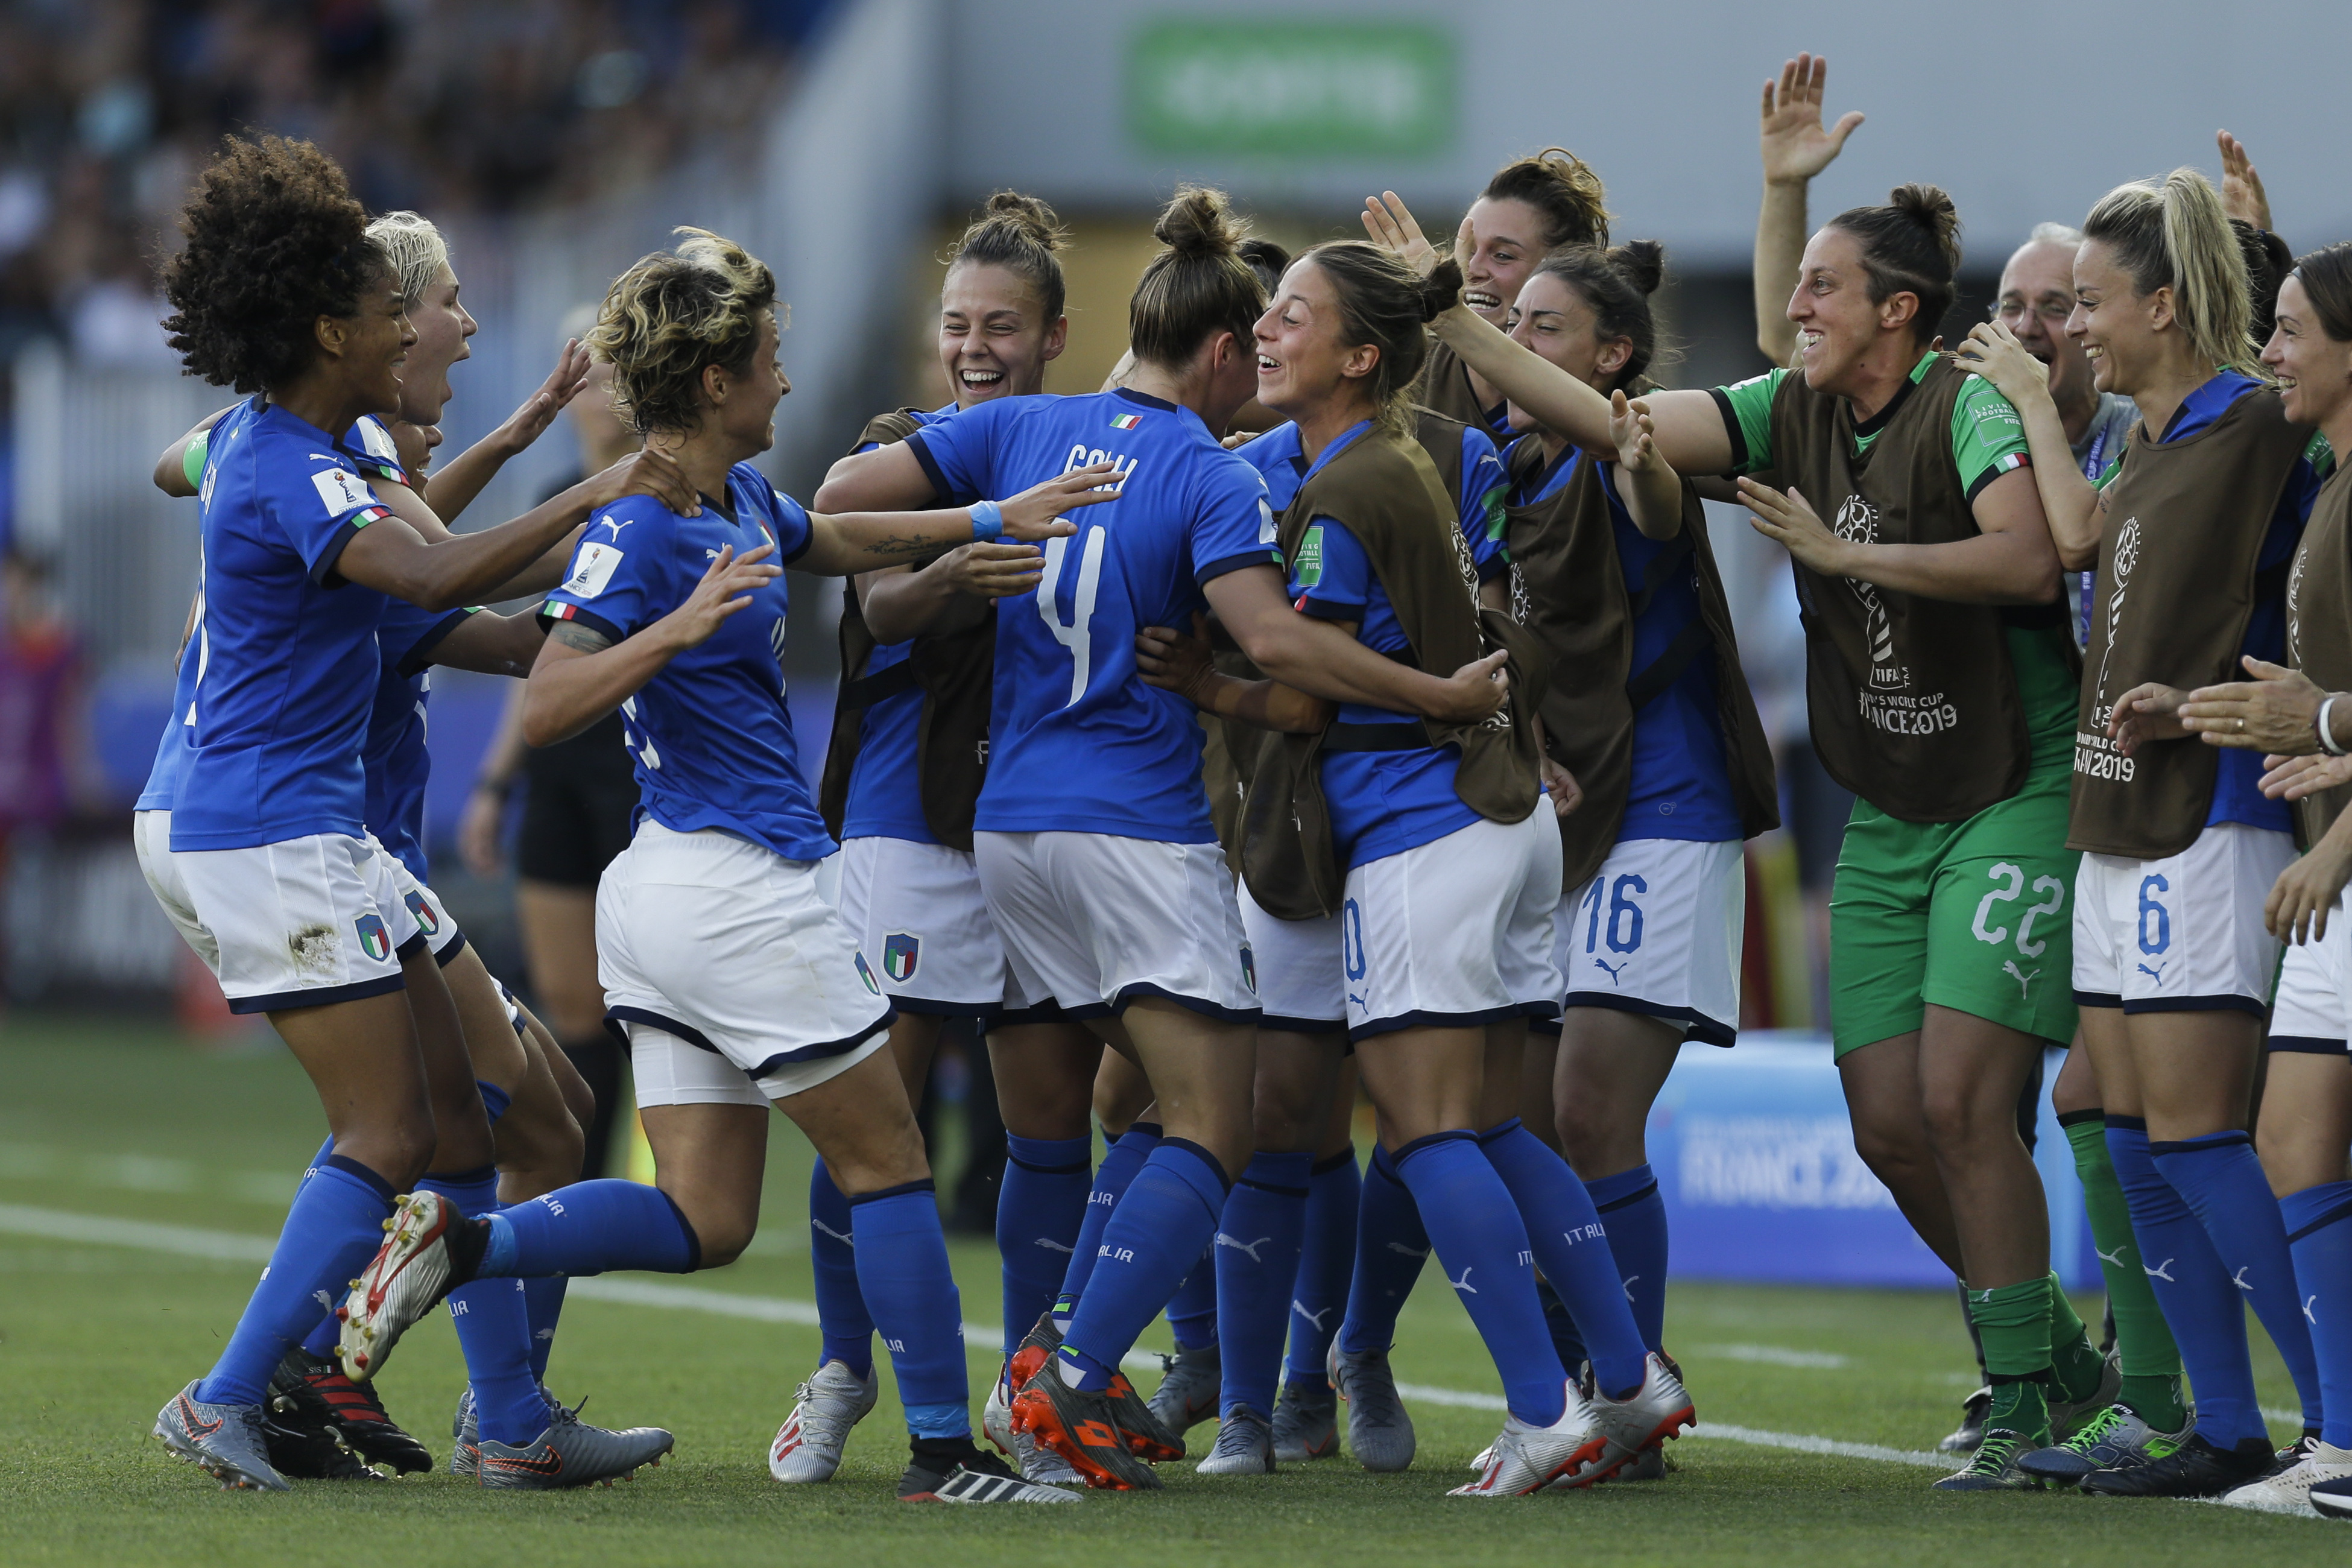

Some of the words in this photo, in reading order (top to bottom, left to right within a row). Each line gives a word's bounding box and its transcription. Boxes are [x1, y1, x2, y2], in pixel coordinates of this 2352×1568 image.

[1036, 517, 1106, 708] 4
[1920, 692, 1944, 707] CUP
[2090, 751, 2136, 782] 2019
[1582, 873, 1648, 954] 16
[1971, 862, 2065, 958] 22
[2138, 873, 2170, 956] 6
[1098, 1245, 1134, 1263] ALIA
